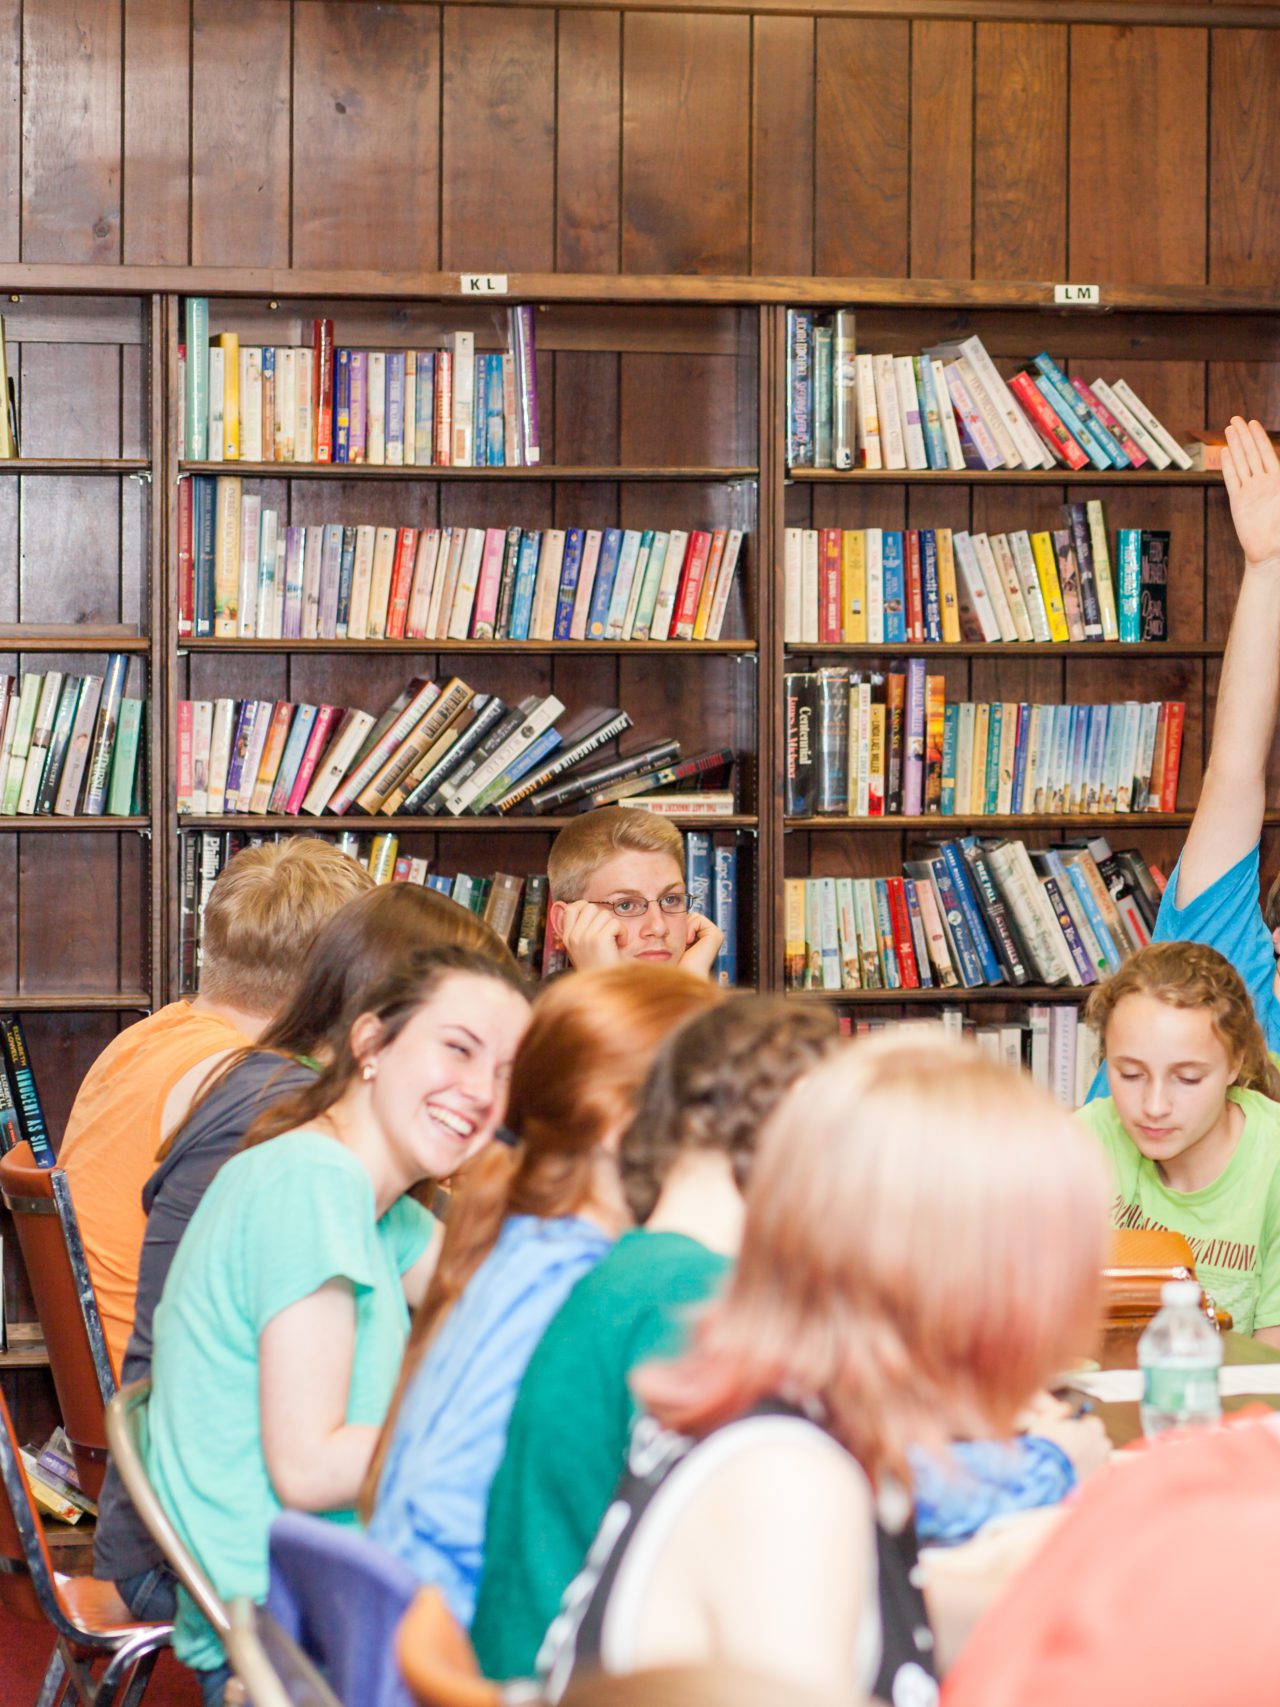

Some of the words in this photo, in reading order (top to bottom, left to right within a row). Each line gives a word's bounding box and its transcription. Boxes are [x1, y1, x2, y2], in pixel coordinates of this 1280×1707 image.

[913, 665, 924, 688] LINDA
[787, 696, 799, 725] James
[912, 706, 923, 734] MILLER
[799, 706, 812, 765] Centennial
[870, 720, 880, 738] LINDA
[787, 736, 799, 780] Michener
[870, 738, 879, 752] LAEL
[870, 752, 879, 774] MILLER
[500, 779, 539, 811] ASSOCIATE
[199, 837, 220, 878] Phillip
[715, 852, 733, 878] Cape
[720, 879, 733, 903] Cod
[975, 860, 989, 883] FREE
[983, 883, 998, 905] FALL
[7, 1031, 18, 1063] LOWELL
[13, 1025, 27, 1066] ELIZABETH
[15, 1068, 40, 1117] INNOCENT
[27, 1119, 42, 1132] AS
[31, 1134, 47, 1152] SIN
